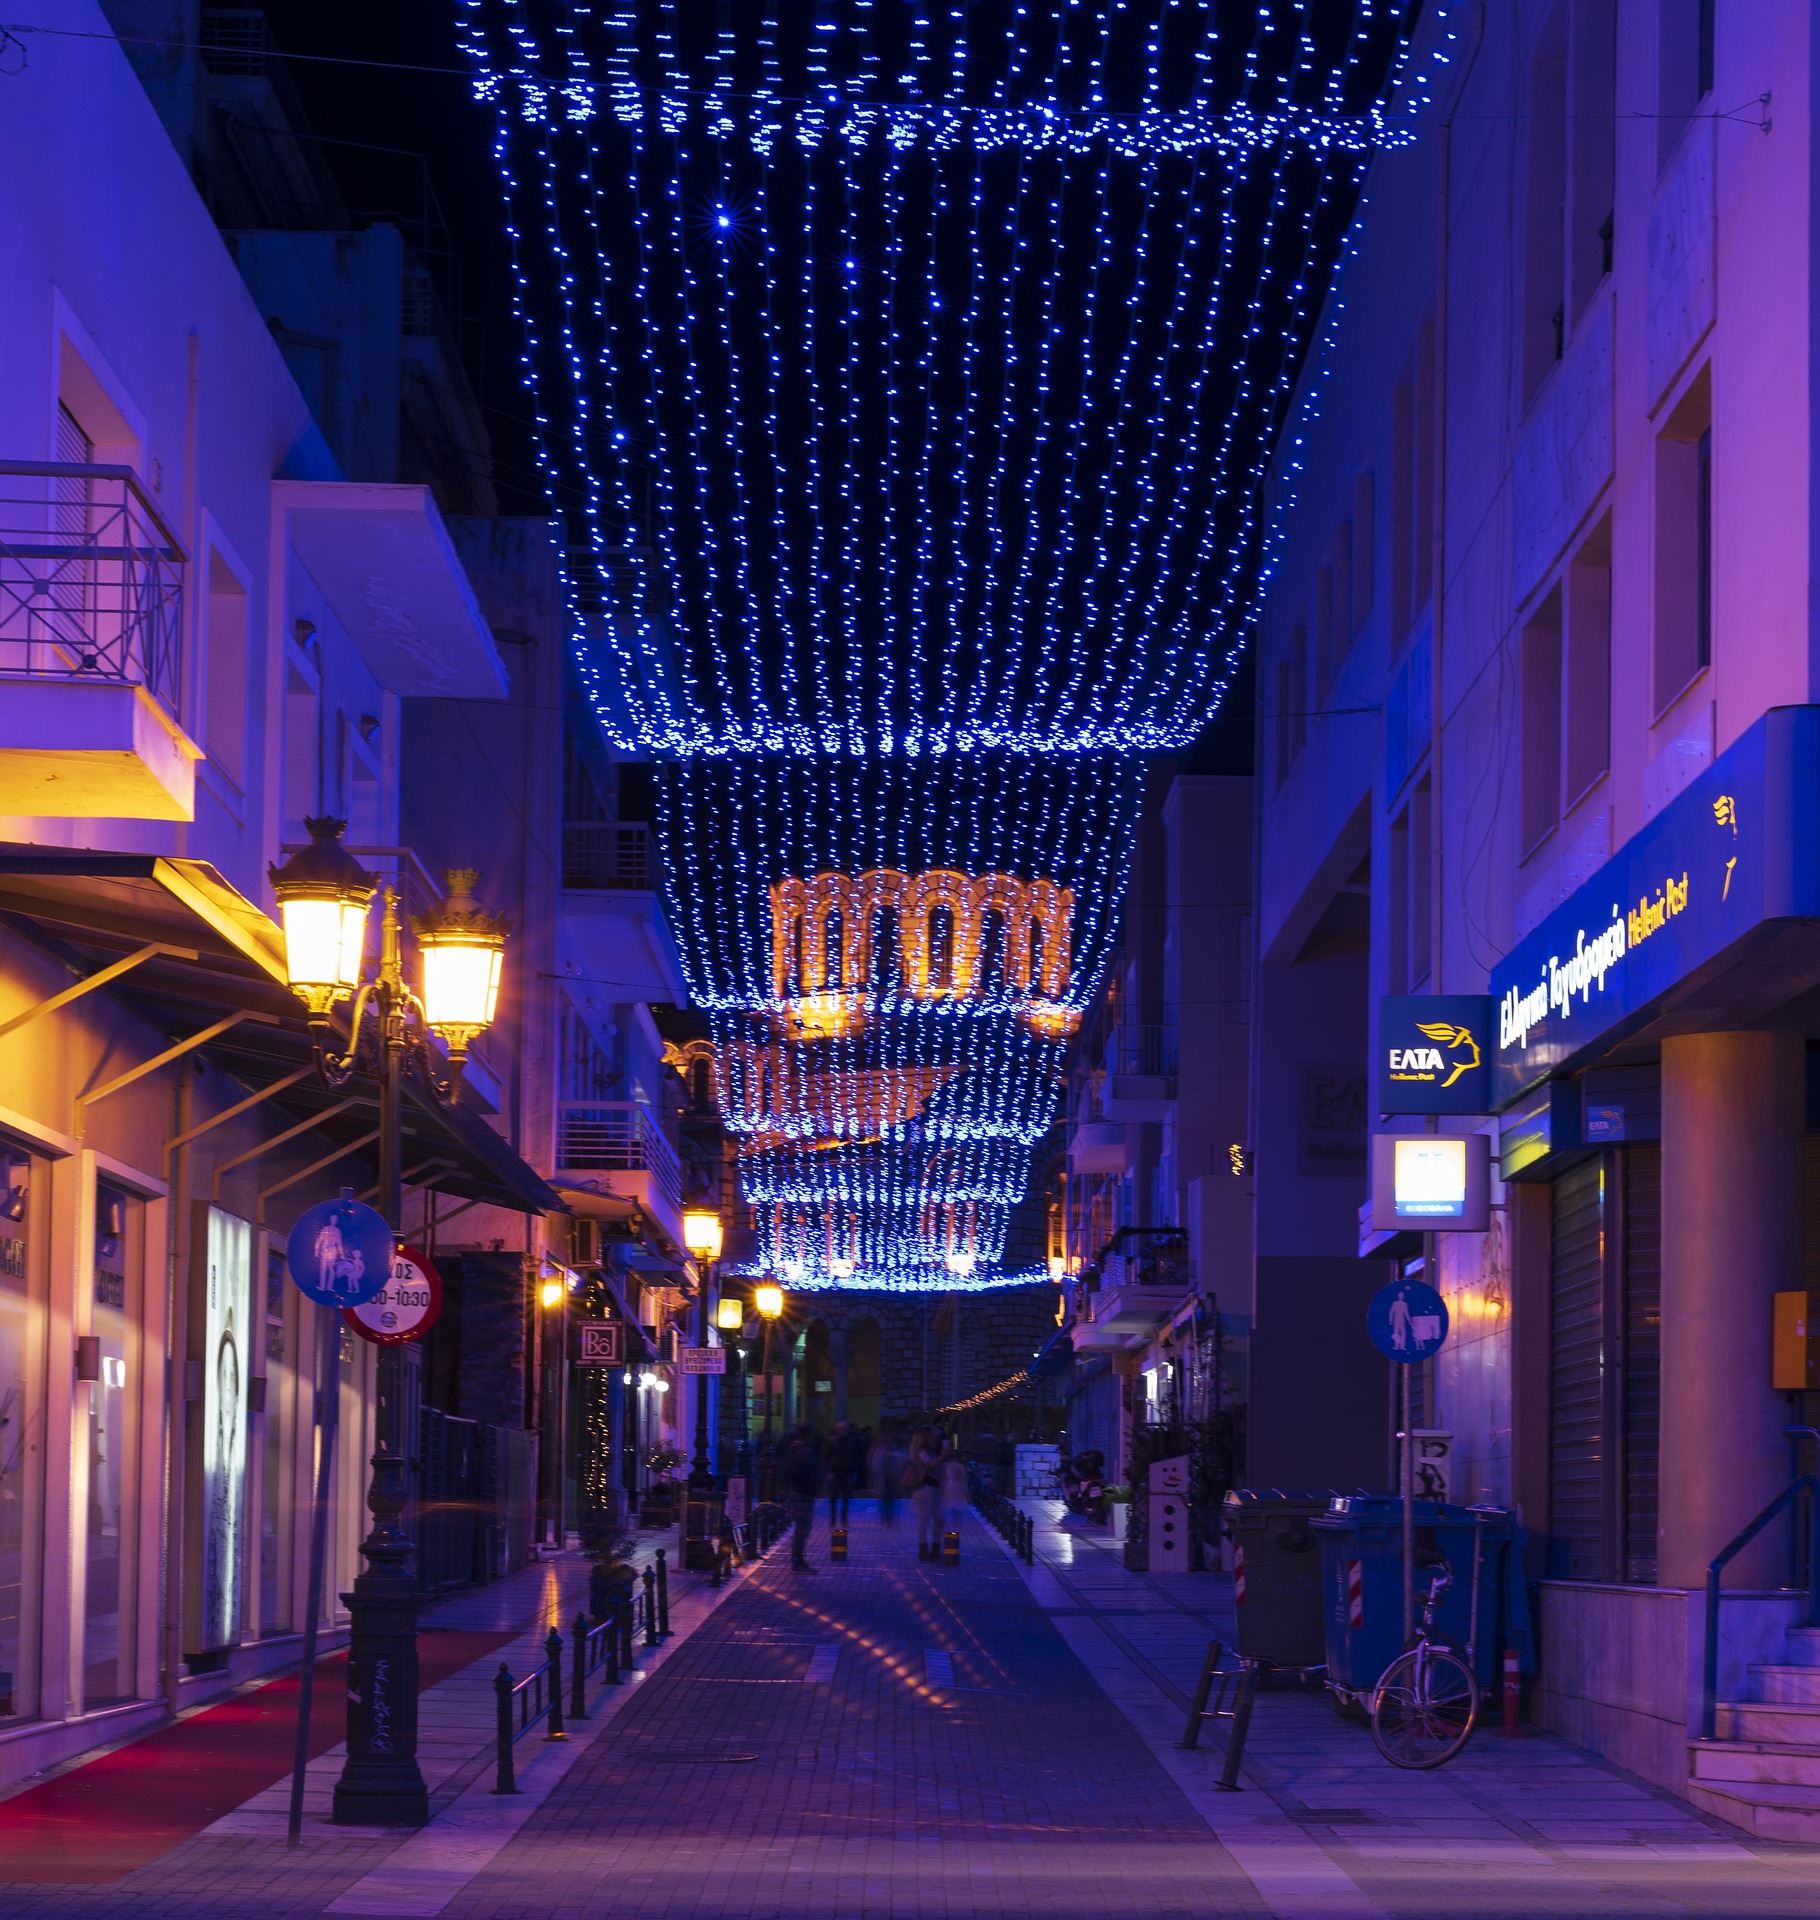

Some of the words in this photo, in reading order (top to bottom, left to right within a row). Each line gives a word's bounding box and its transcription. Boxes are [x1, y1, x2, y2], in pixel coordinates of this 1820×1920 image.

[1628, 888, 1666, 949] Hellenic
[1666, 871, 1688, 919] Post
[1500, 964, 1548, 1050] Ελληνικά
[1389, 1048, 1445, 1070] ΕΛΤΑ
[390, 1263, 413, 1280] ΟΣ
